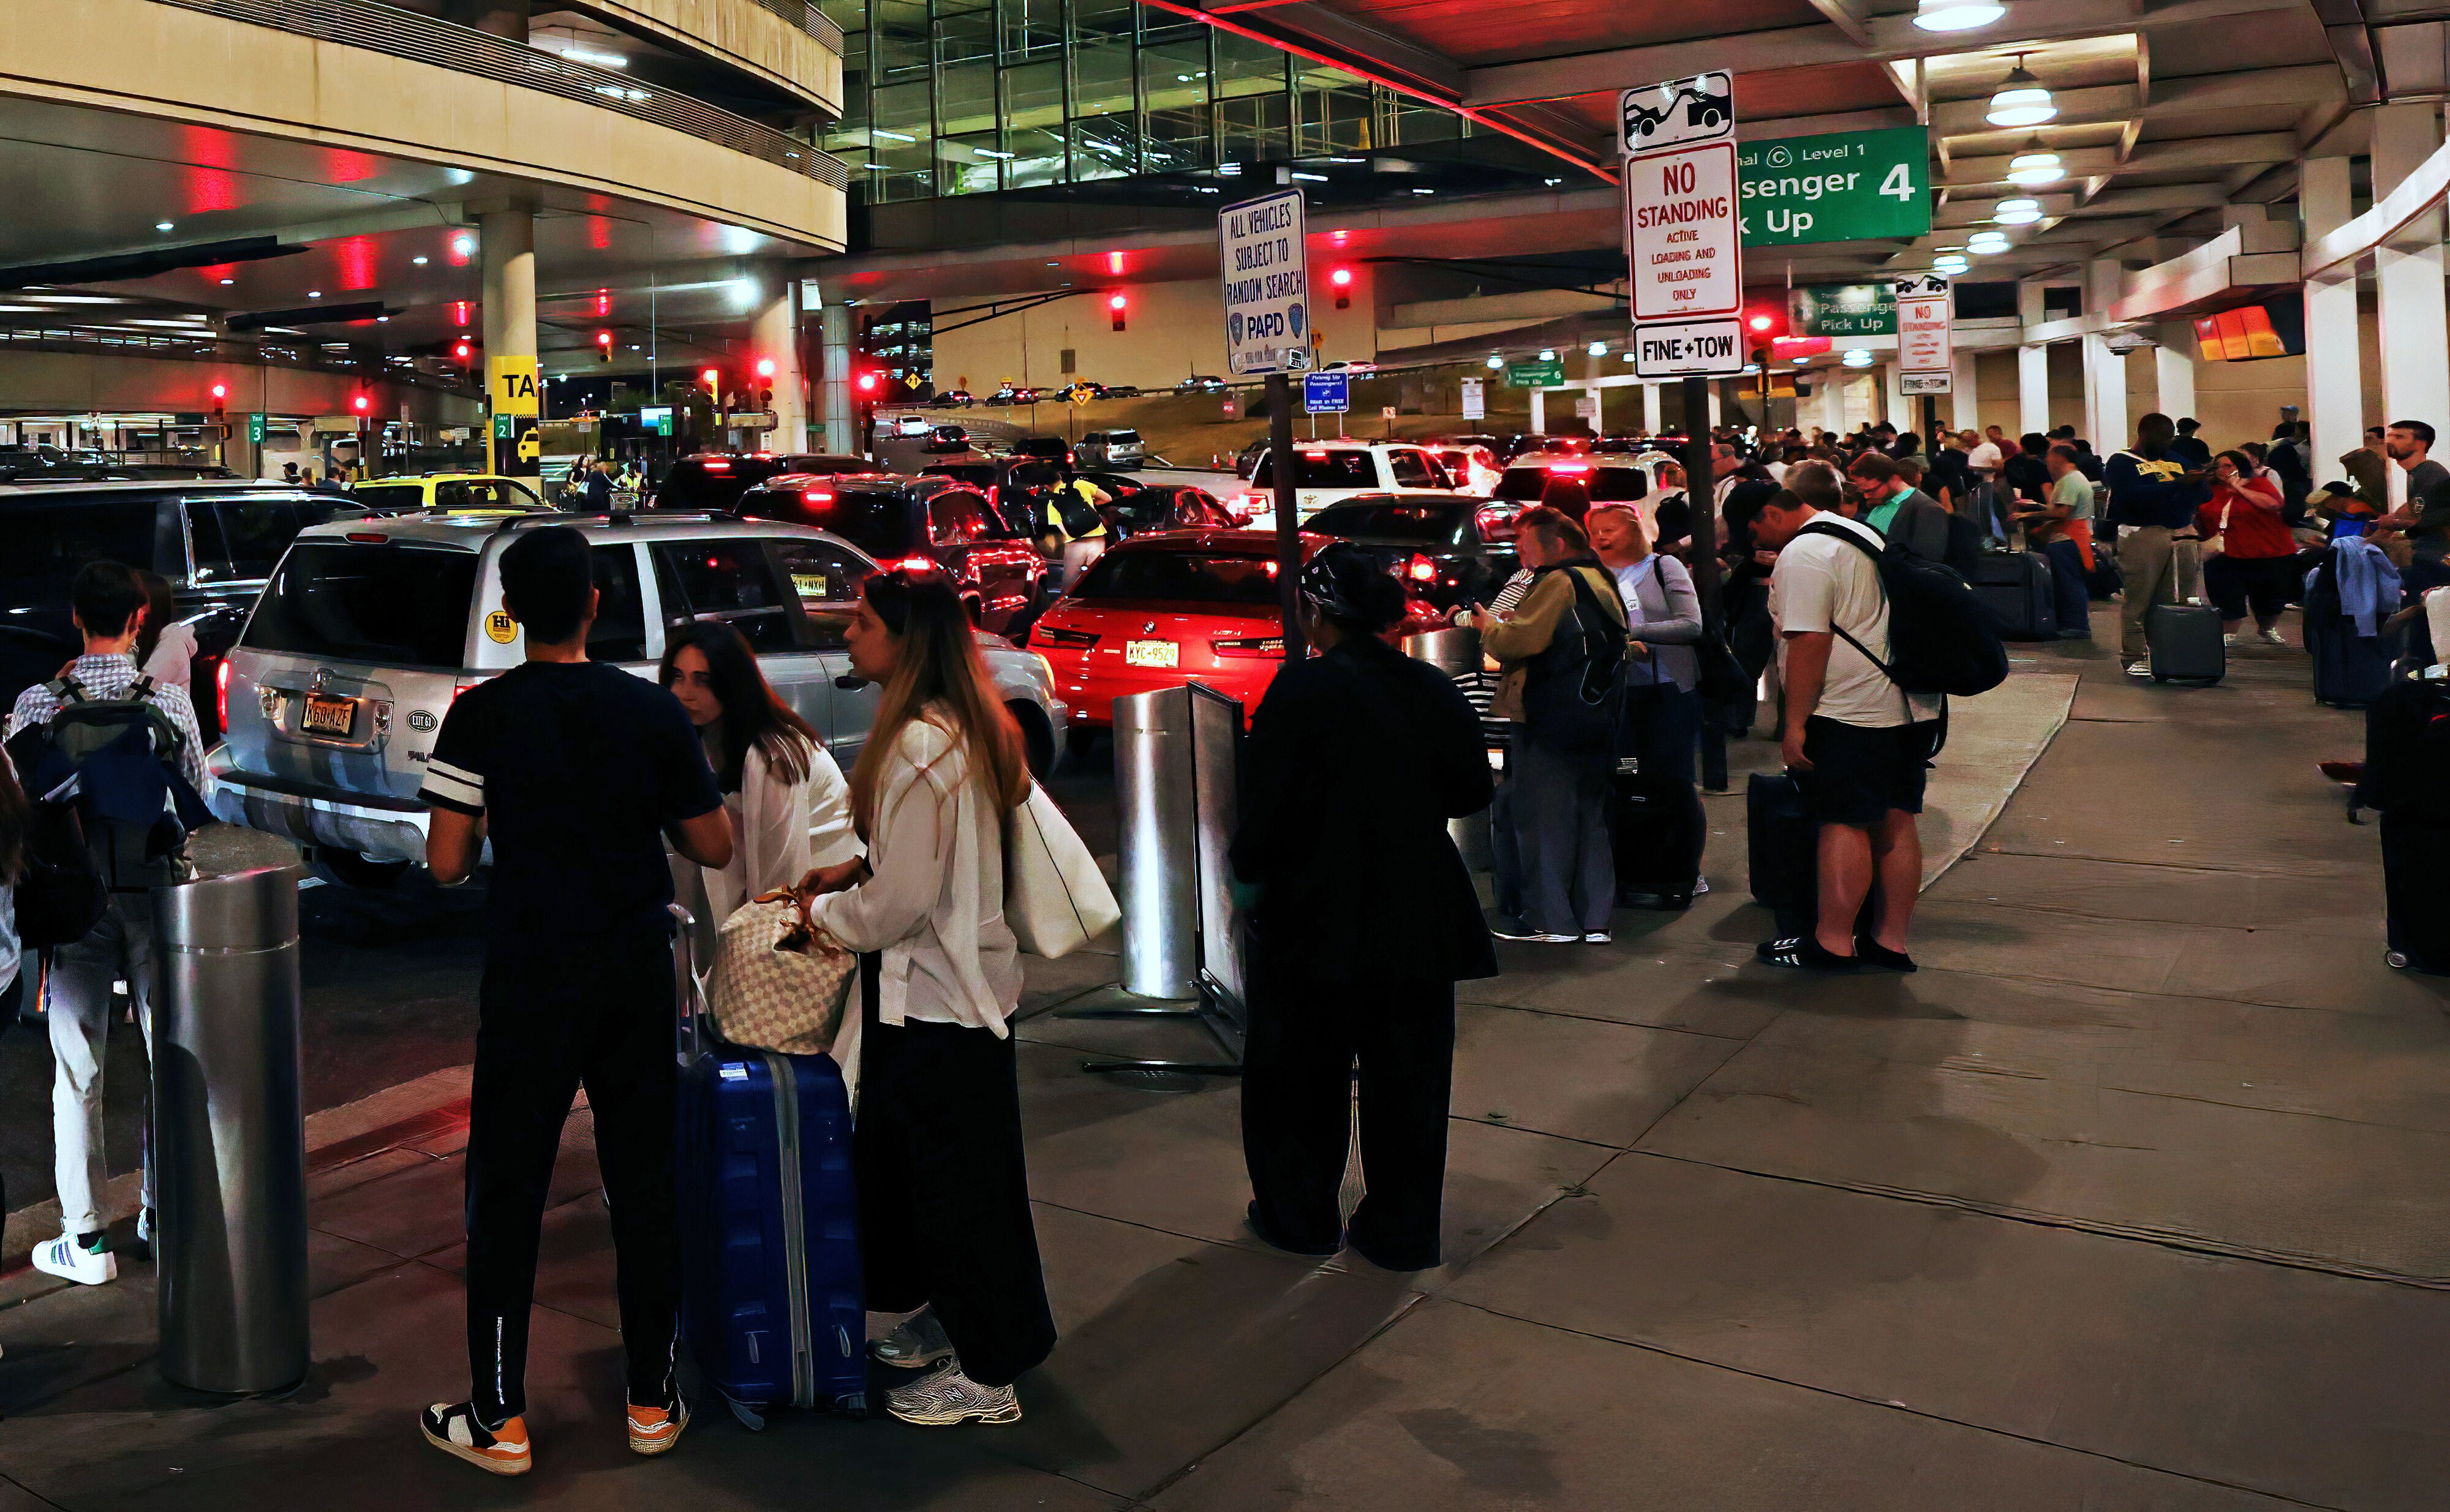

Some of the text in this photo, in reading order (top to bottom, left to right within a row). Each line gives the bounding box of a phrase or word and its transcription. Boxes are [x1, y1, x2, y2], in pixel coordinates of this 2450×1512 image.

[1803, 145, 1848, 160] Level
[1857, 144, 1864, 156] 1
[1664, 162, 1696, 196] NO
[1742, 172, 1860, 200] senger
[1879, 164, 1916, 201] 4
[1231, 202, 1292, 239] ALL VEHICLES
[1637, 197, 1728, 229] STANDING
[1767, 209, 1814, 238] Up
[1667, 230, 1700, 244] ACTIVE
[1235, 238, 1289, 271] SUBJECT TO
[1652, 247, 1716, 265] LOADING AND
[1657, 267, 1711, 284] UNLOADING
[1227, 270, 1303, 307] RANDOM SEARCH
[1672, 288, 1697, 301] ONLY
[1915, 305, 1931, 319] NO
[1248, 312, 1284, 340] PAPD
[1822, 318, 1883, 331] Pick Up
[502, 374, 538, 397] TA
[254, 427, 261, 441] 3
[499, 425, 507, 437] 2
[663, 424, 668, 435] 1
[492, 615, 510, 628] Hi
